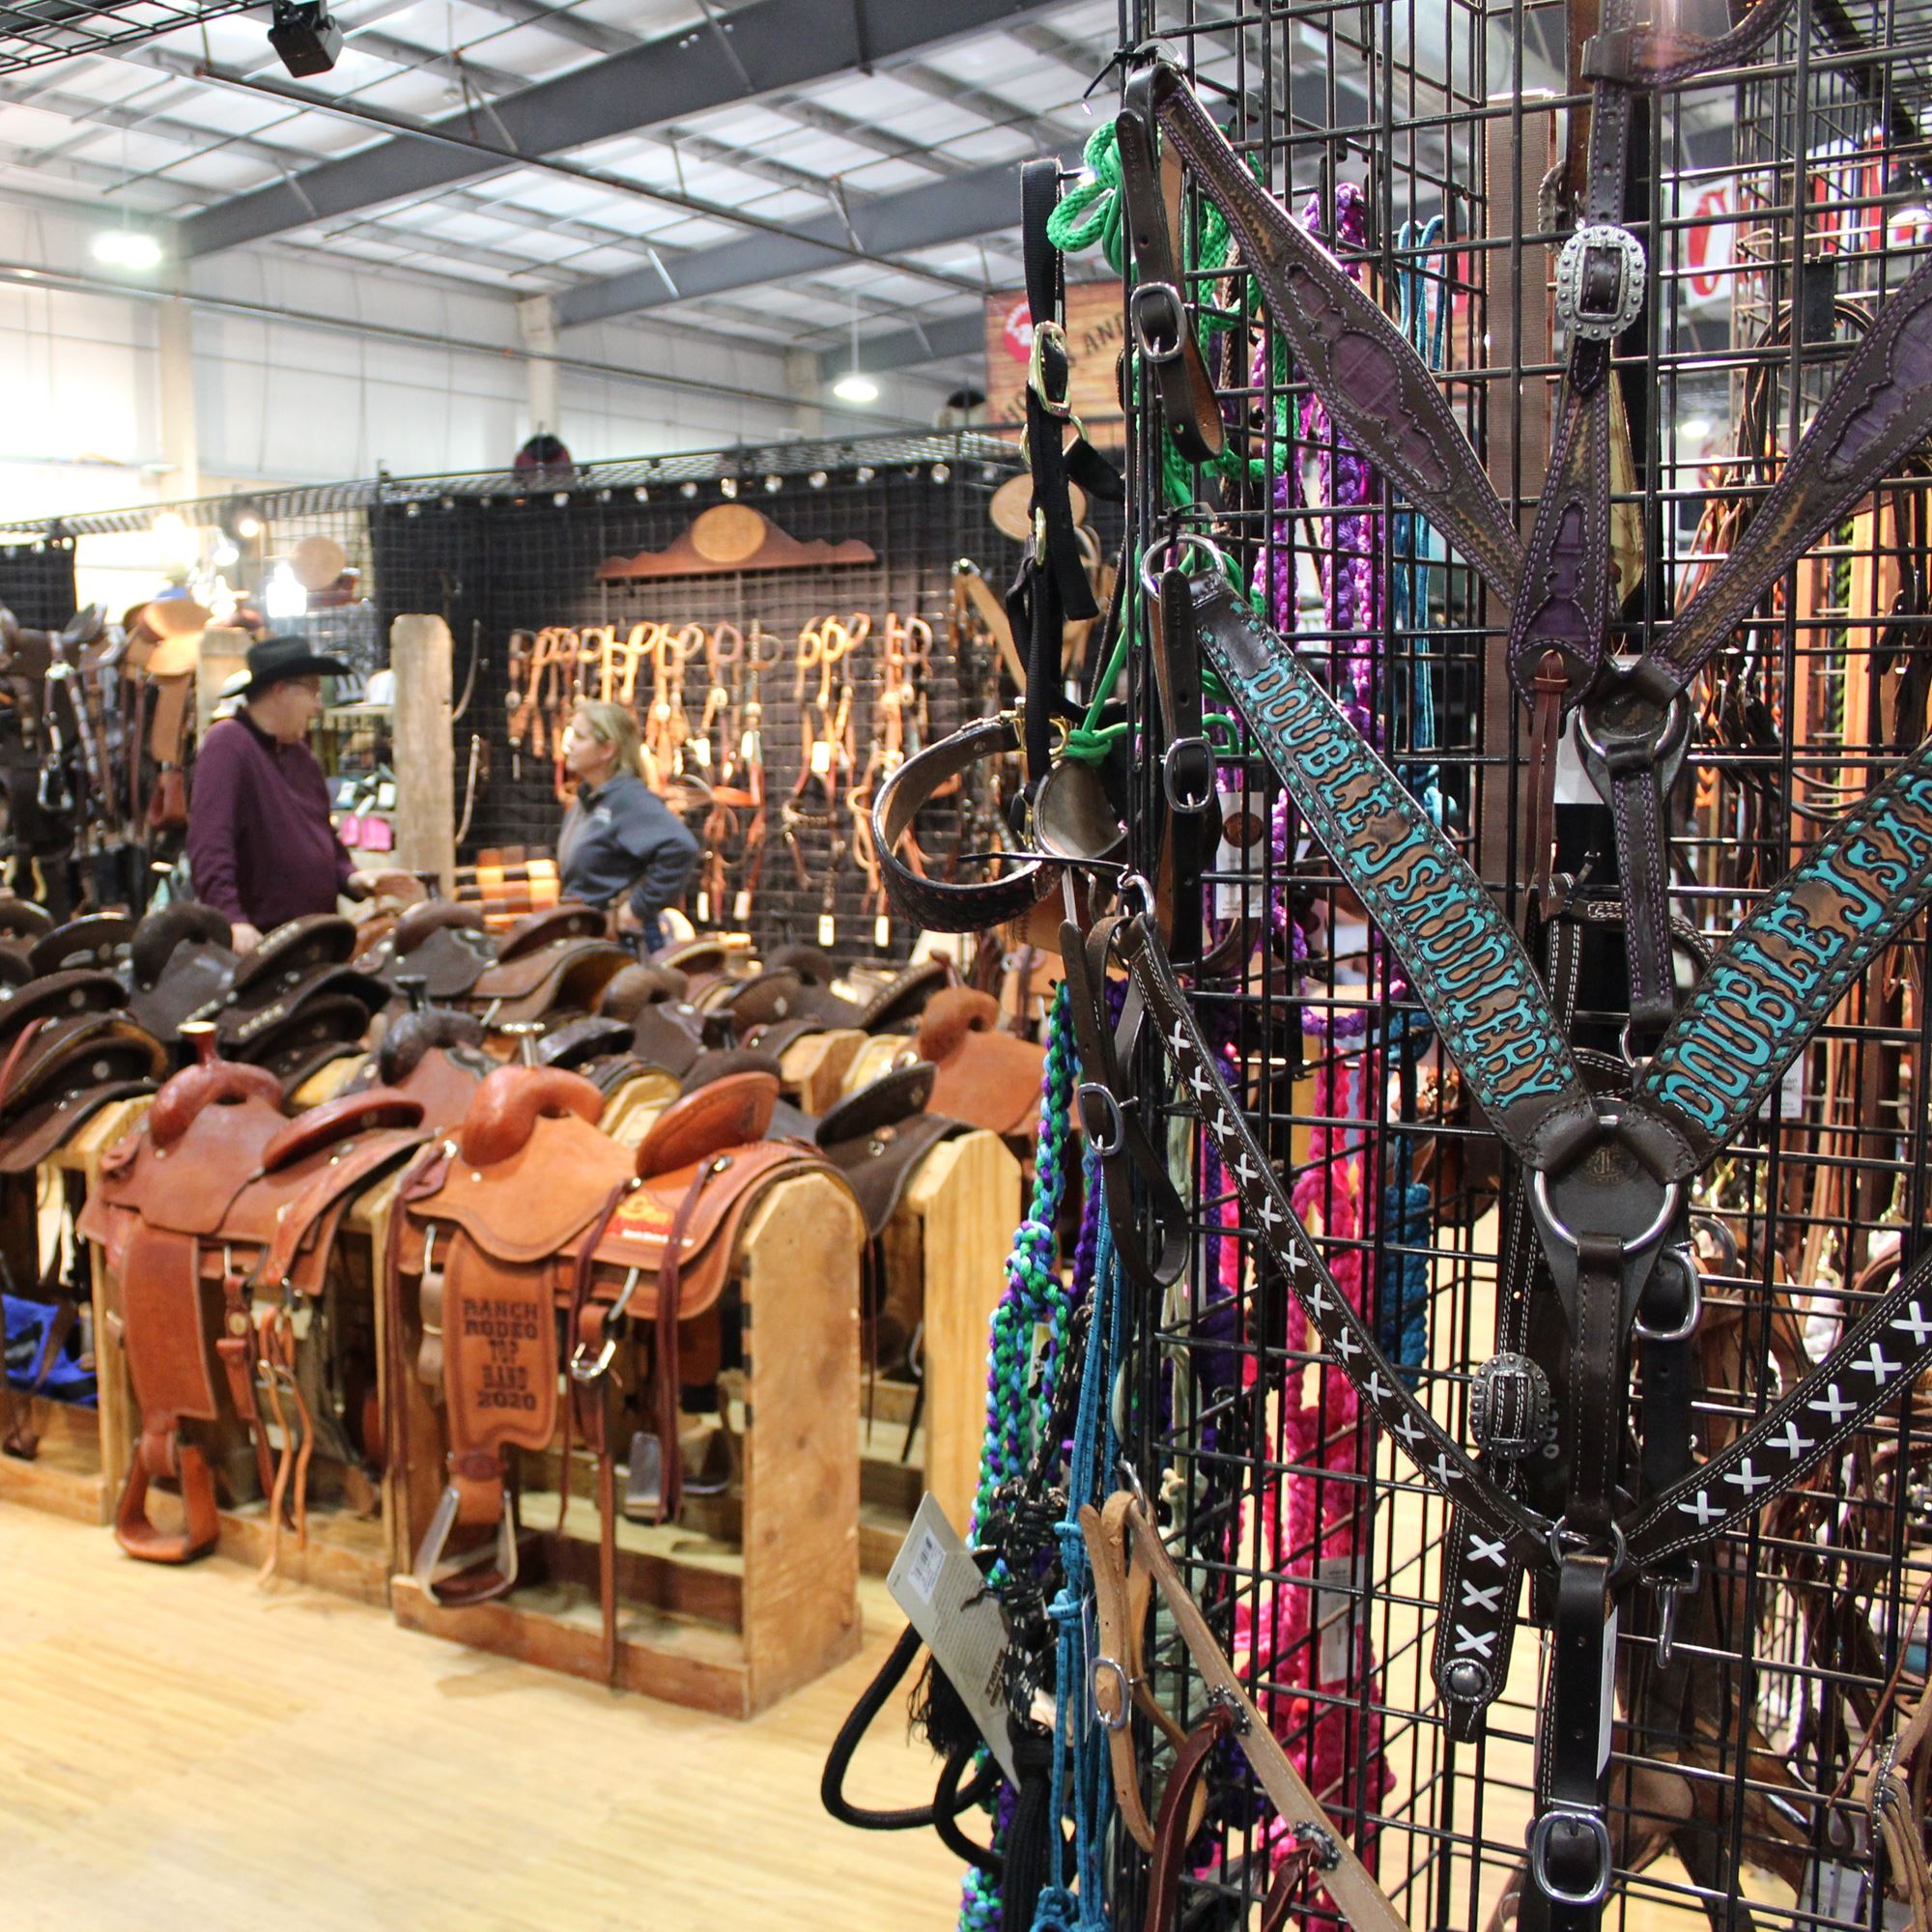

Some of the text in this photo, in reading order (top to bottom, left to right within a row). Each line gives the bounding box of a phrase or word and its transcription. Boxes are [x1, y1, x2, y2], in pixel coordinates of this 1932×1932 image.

[1241, 657, 1563, 1108] DOUBLE J SADDLERY
[1659, 902, 1846, 1130] DOUBLE
[1809, 859, 1884, 933] J
[463, 1297, 538, 1320] RANCH
[465, 1320, 538, 1341] RODEO
[478, 1391, 537, 1411] 2020
